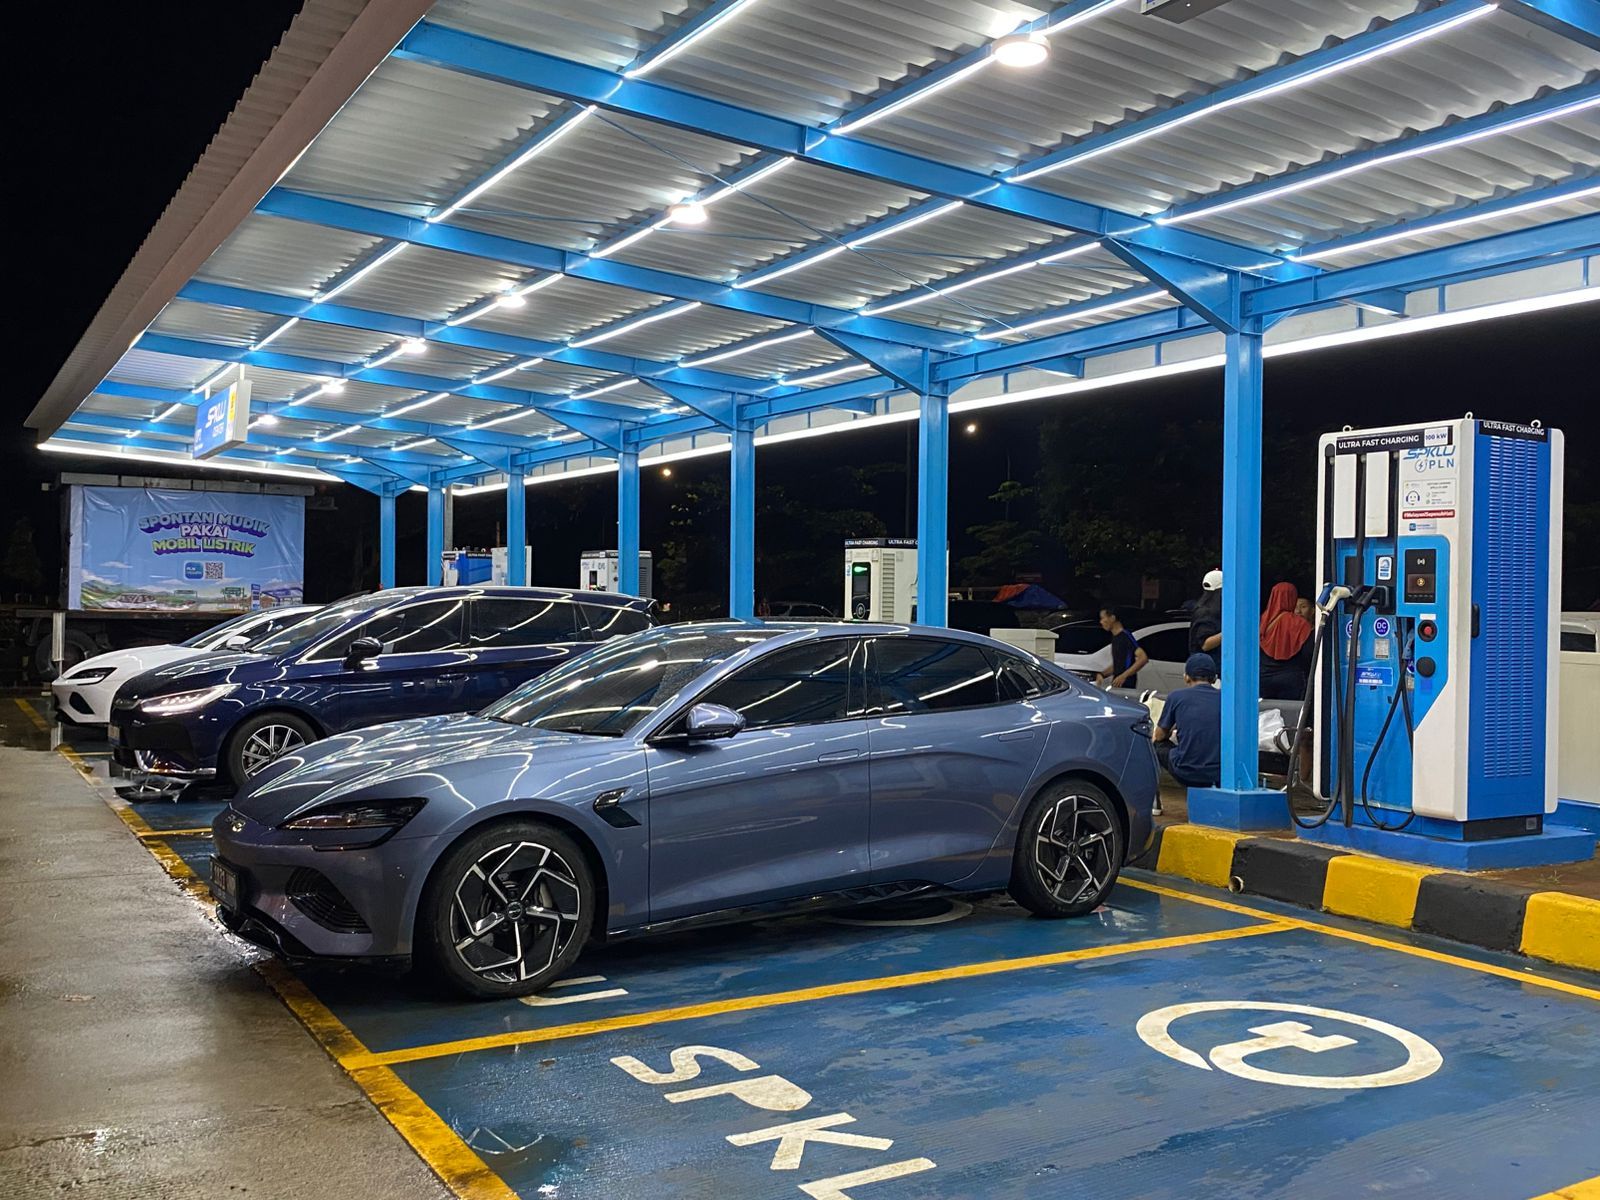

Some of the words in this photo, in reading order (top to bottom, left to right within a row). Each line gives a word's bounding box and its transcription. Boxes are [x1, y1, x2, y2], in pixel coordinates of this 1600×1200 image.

[1483, 420, 1501, 429] ULTRA
[1502, 424, 1515, 432] FAST
[1516, 426, 1545, 436] CHARGING
[1338, 440, 1360, 449] ULTRA
[1362, 438, 1379, 447] FAST
[1380, 434, 1420, 445] CHARGING
[1403, 446, 1456, 460] SPKLU
[1429, 459, 1455, 469] PLN
[139, 511, 214, 532] SPONTAN
[219, 512, 271, 536] MUDIK
[181, 523, 230, 538] PAKAI
[152, 538, 201, 554] MOBIL
[202, 538, 256, 556] LISTRIK
